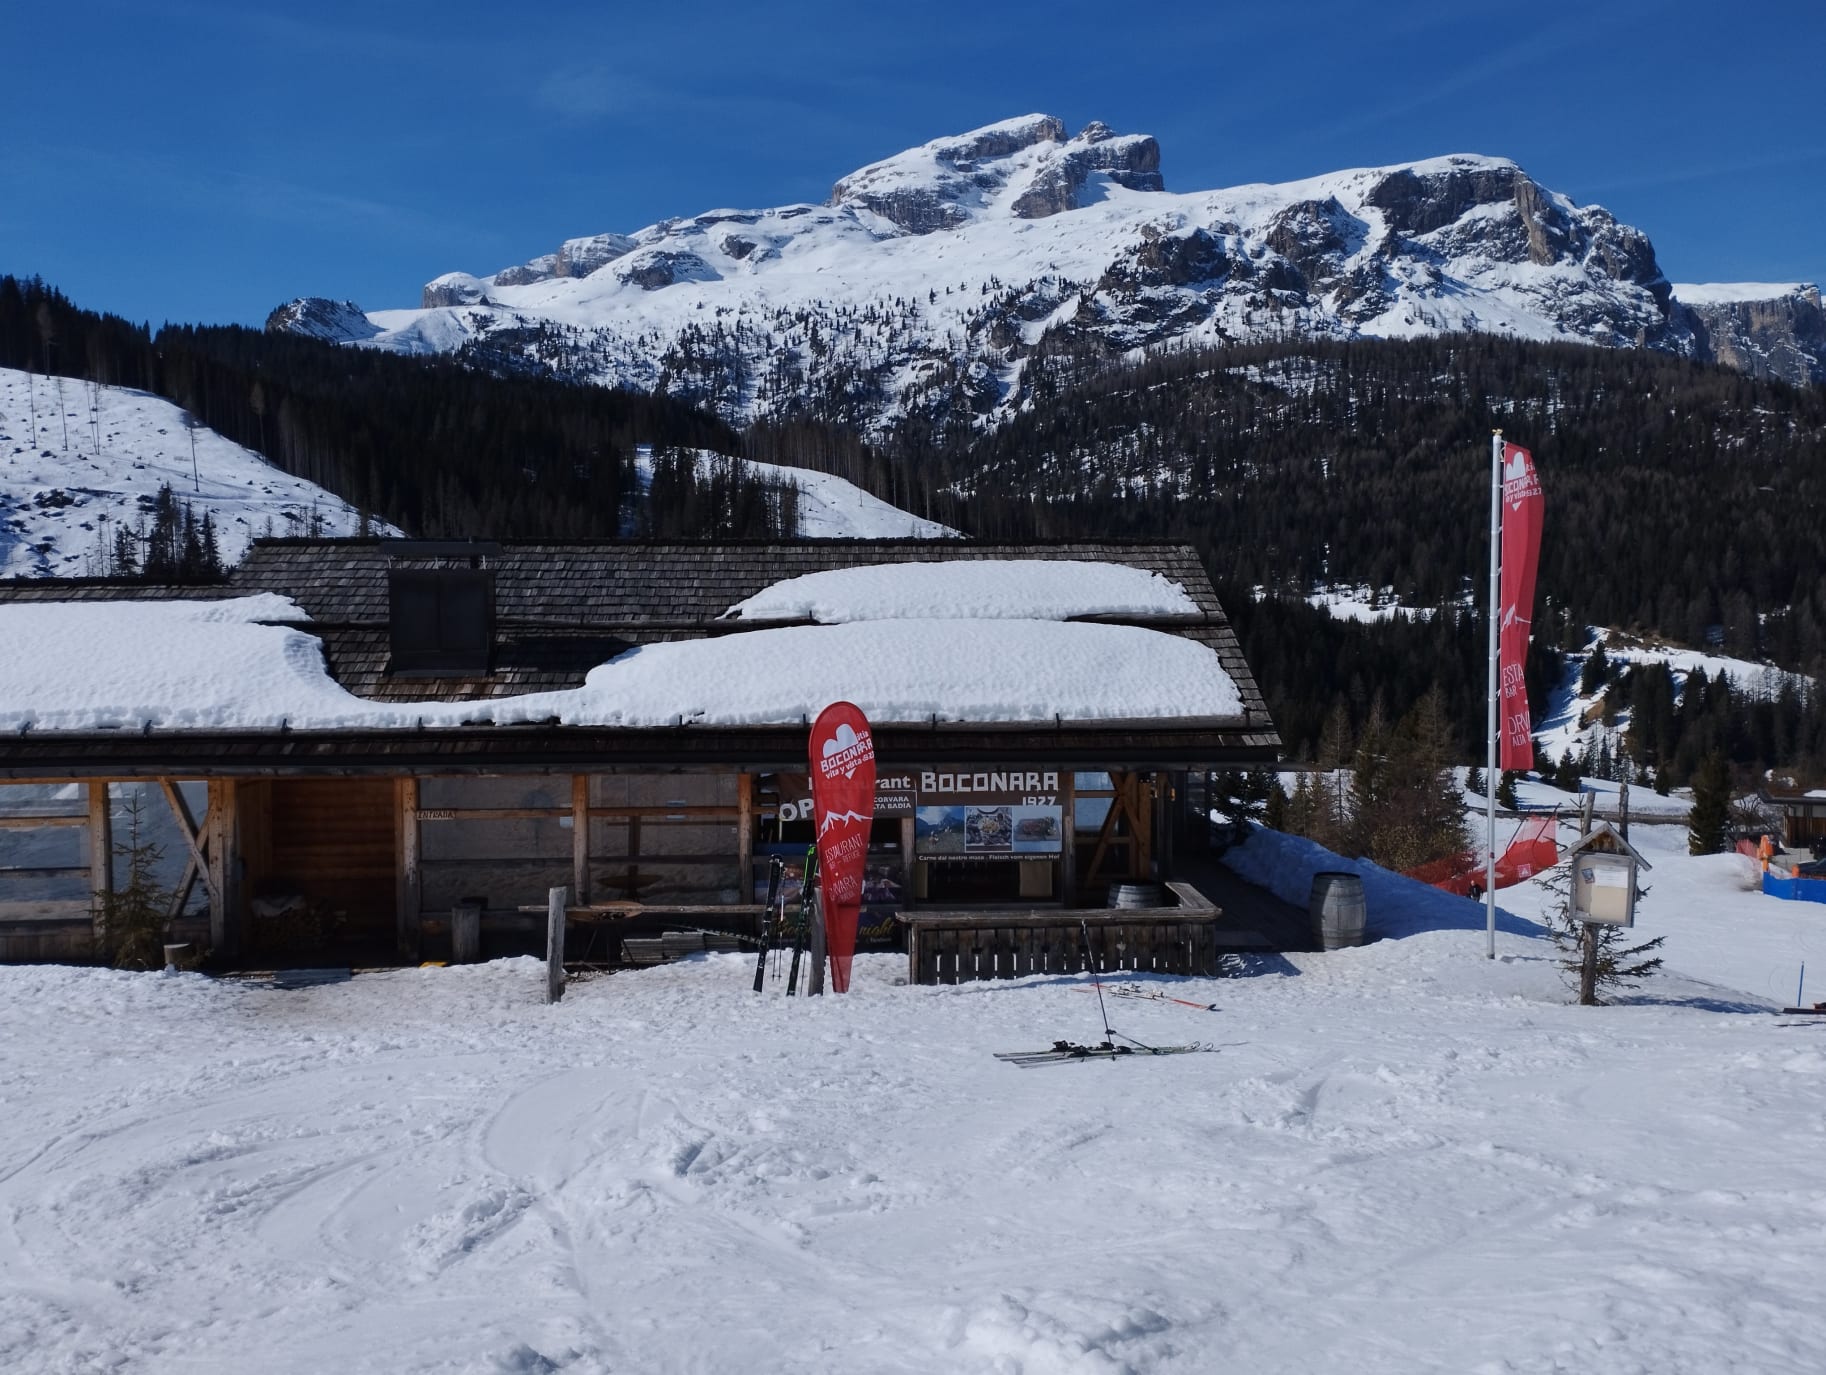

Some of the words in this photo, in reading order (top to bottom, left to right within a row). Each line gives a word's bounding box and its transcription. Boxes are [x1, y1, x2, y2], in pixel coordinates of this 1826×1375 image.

[1503, 663, 1525, 687] ESTA
[825, 768, 840, 780] vita
[921, 771, 1059, 793] BOCONARA
[824, 833, 864, 864] ESTAURANT
